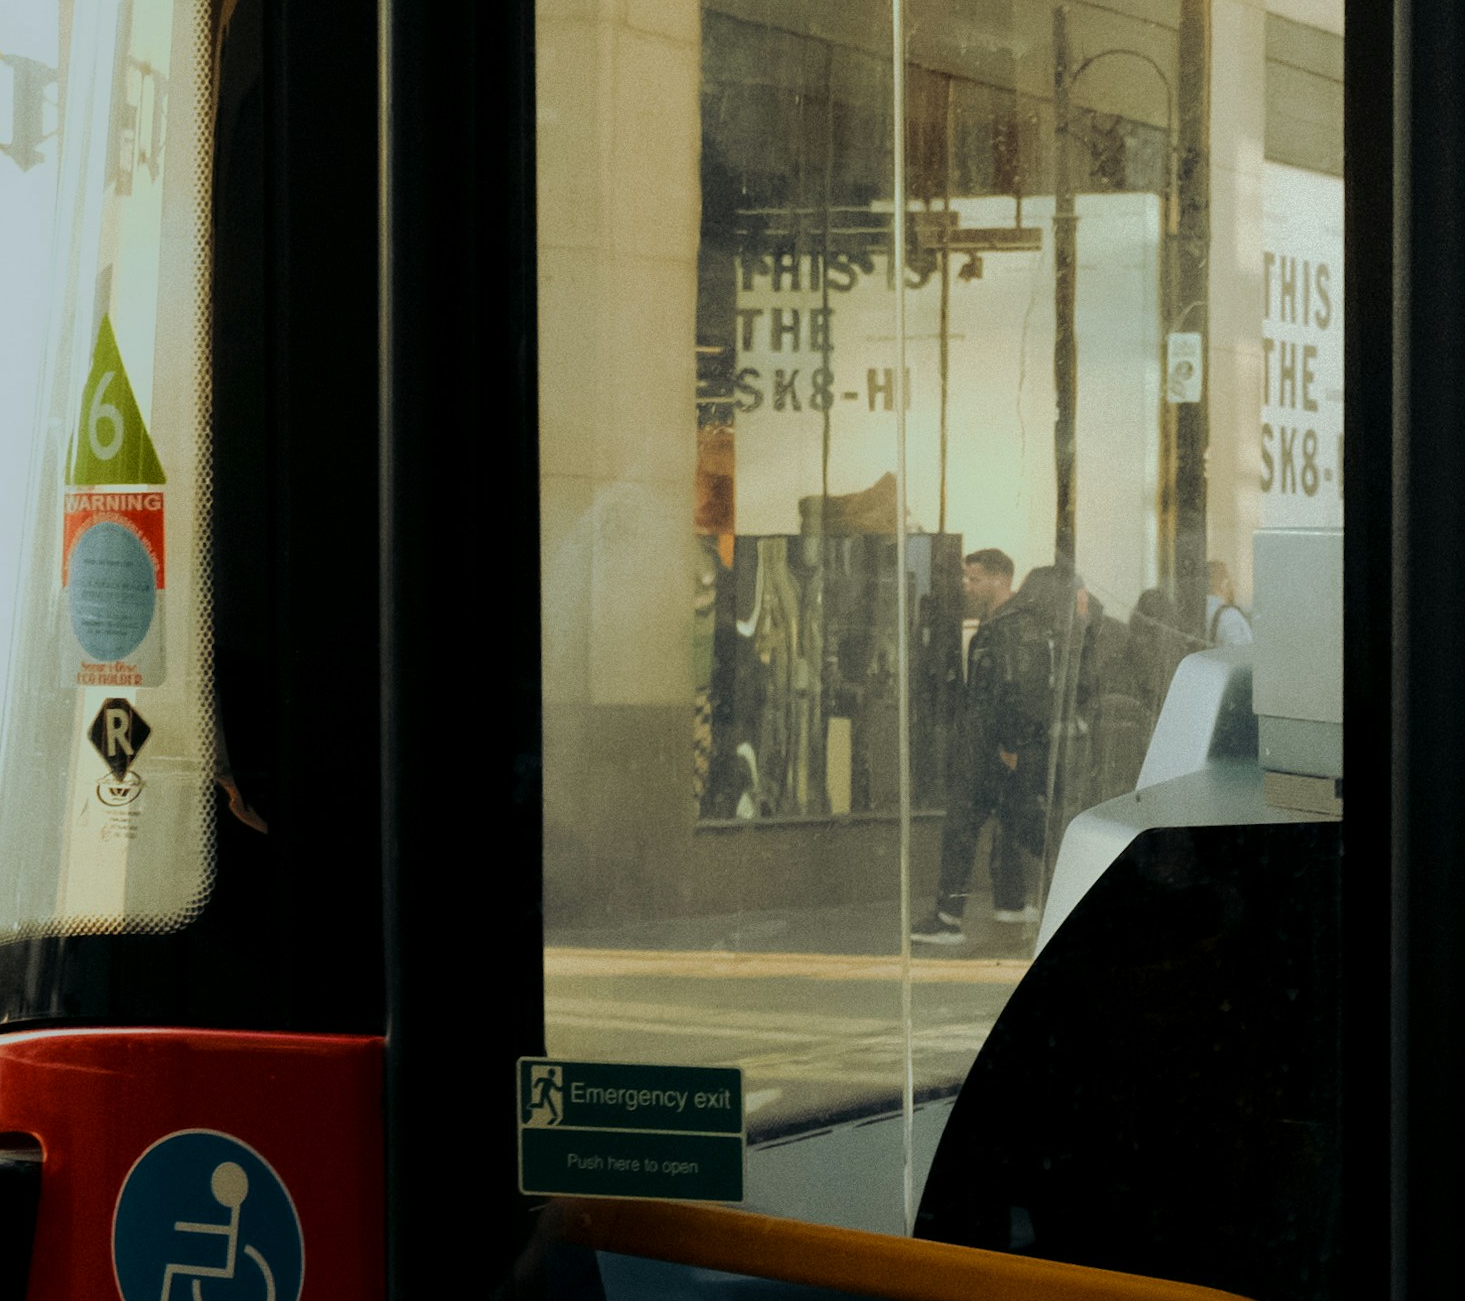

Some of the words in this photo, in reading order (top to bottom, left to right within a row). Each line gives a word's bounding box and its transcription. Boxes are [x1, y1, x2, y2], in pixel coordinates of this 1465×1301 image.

[1263, 251, 1332, 331] THIS
[736, 307, 835, 353] THE
[1262, 337, 1318, 413] THE
[88, 370, 126, 462] 6
[1258, 422, 1345, 498] SK8-
[105, 708, 135, 758] R
[570, 1081, 689, 1113] Emergency
[693, 1087, 732, 1110] exit
[566, 1152, 604, 1171] Push
[607, 1155, 641, 1173] here
[643, 1158, 659, 1174] to
[661, 1161, 699, 1177] open
